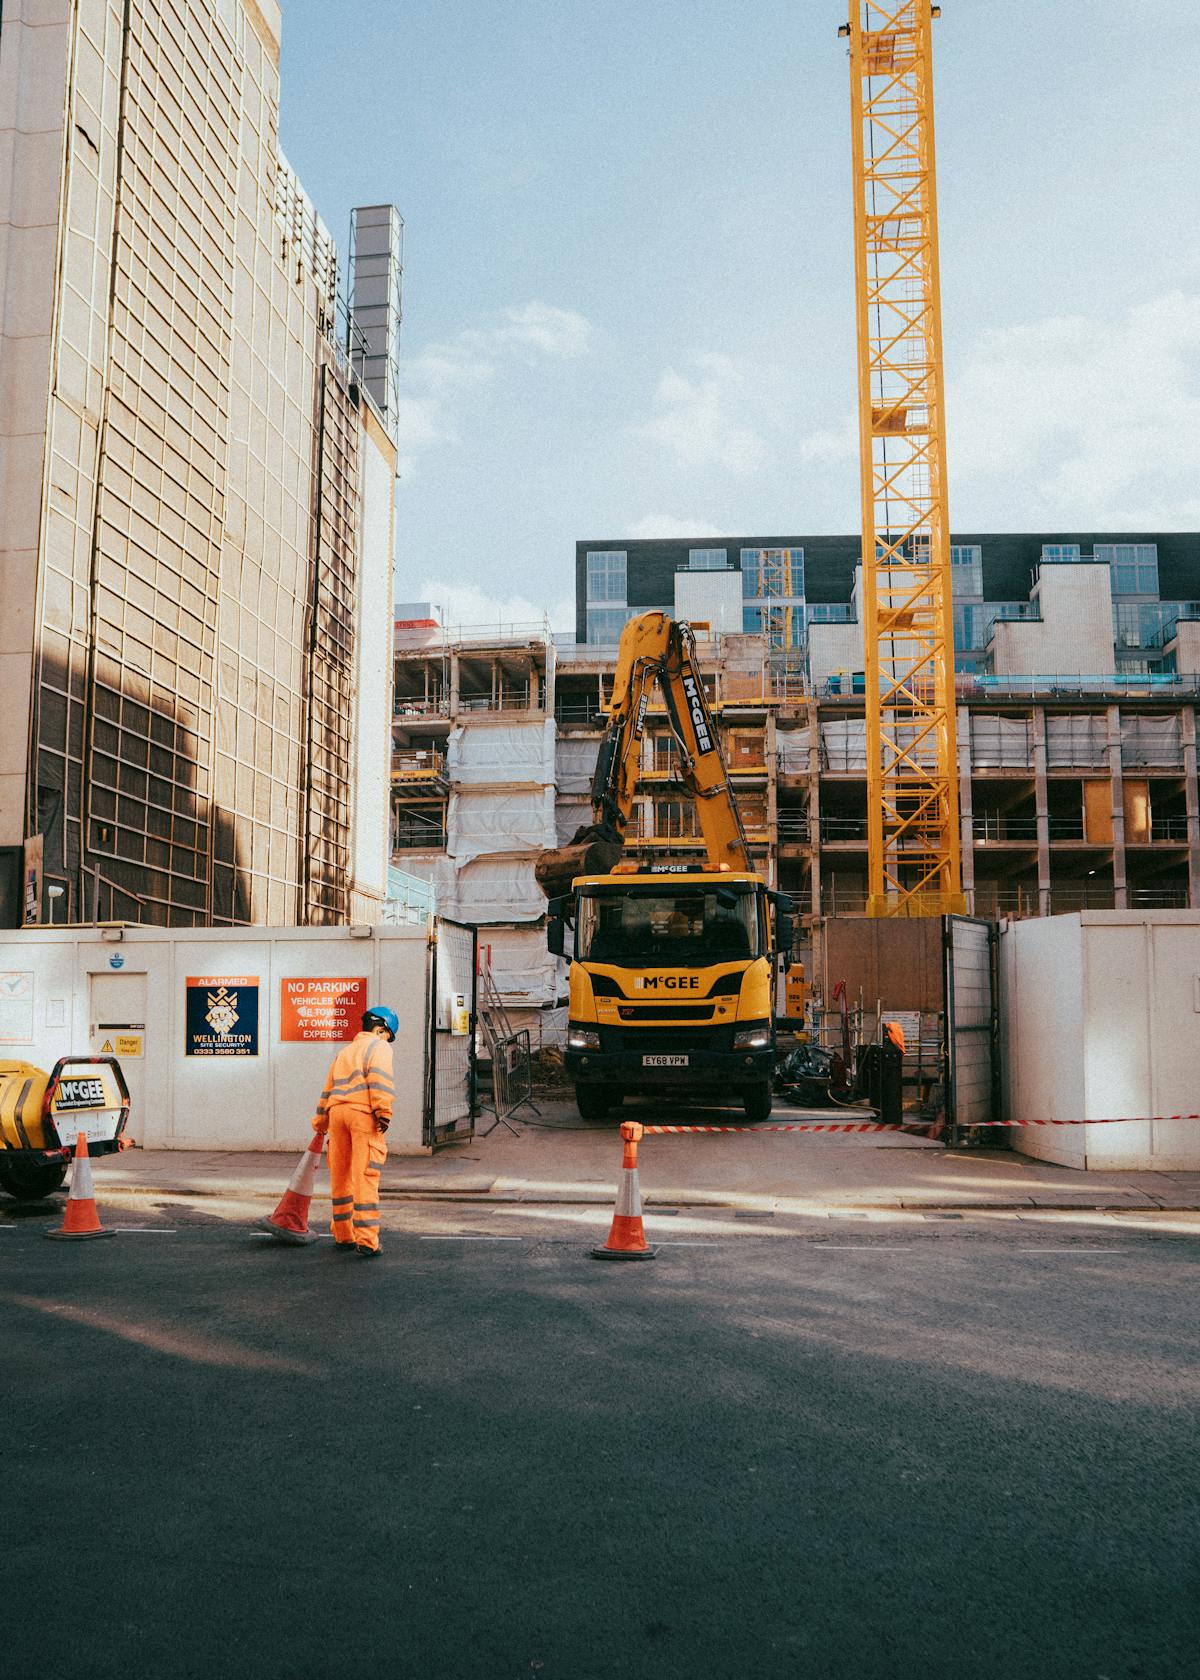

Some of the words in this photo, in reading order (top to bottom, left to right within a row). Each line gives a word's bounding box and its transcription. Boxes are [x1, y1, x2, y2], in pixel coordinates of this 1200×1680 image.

[198, 978, 248, 986] ALARMED
[643, 976, 699, 989] McGEE
[287, 982, 305, 993] NO
[307, 982, 360, 993] PARKING
[291, 997, 333, 1005] VEHICLES
[334, 997, 356, 1005] WILL
[315, 1008, 347, 1016] TOWED
[297, 1019, 309, 1027] AT
[310, 1019, 349, 1027] OWNERS
[303, 1030, 343, 1038] EXPENSE
[193, 1034, 252, 1043] WELLINGTON
[645, 1056, 668, 1065] EY68
[60, 1080, 104, 1101] McGEE
